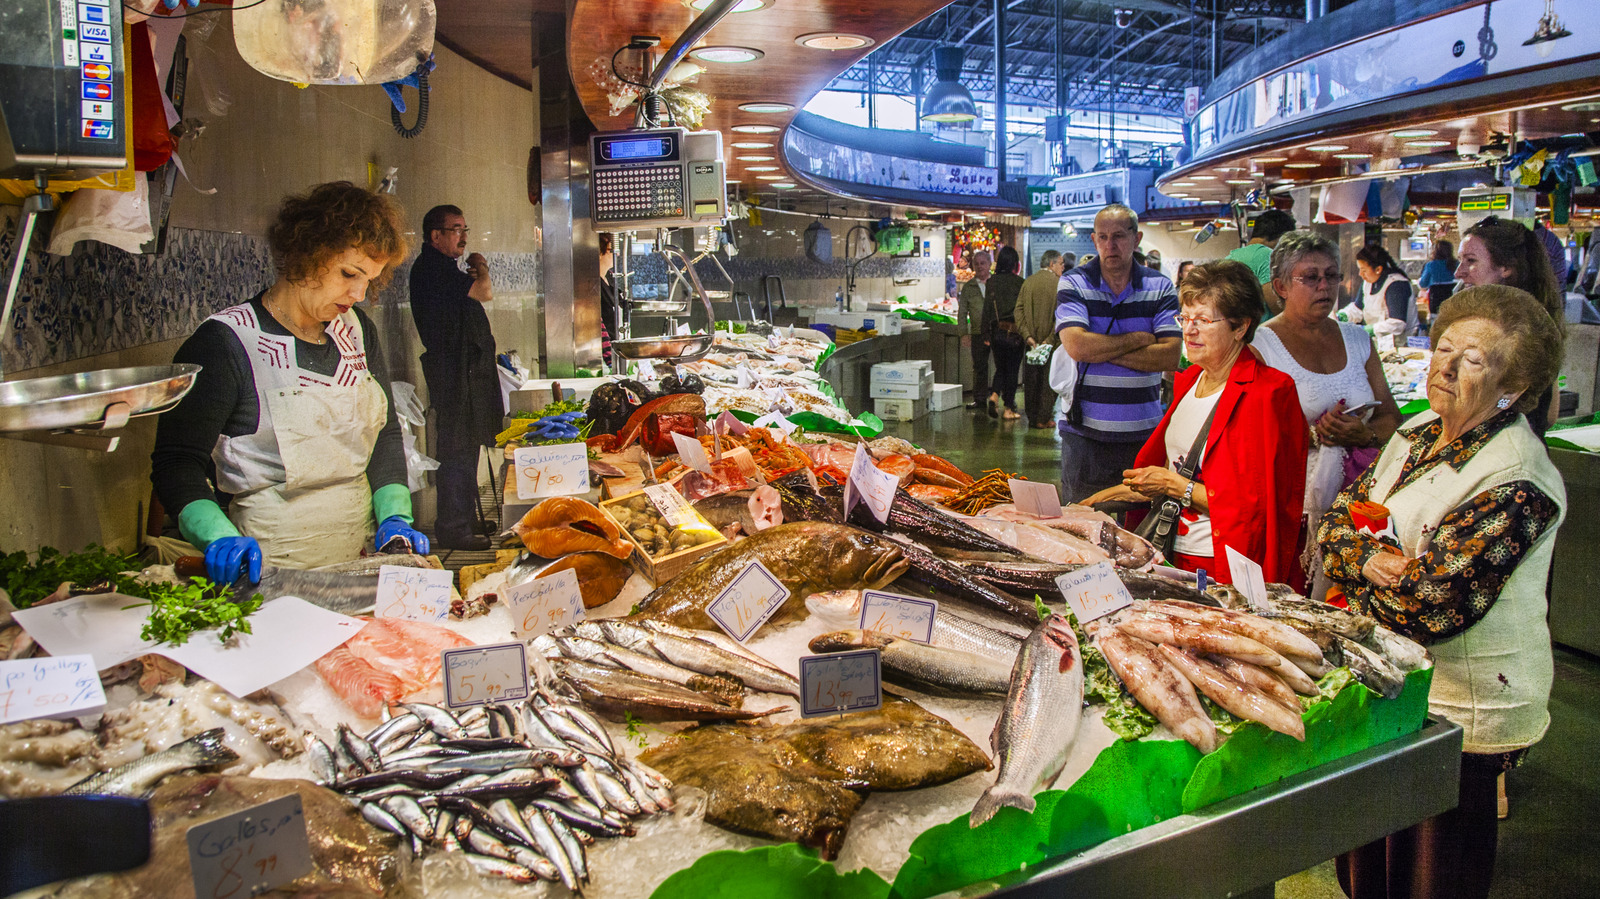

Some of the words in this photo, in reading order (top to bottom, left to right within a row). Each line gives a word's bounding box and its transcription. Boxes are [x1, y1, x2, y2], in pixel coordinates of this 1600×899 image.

[86, 27, 107, 36] VISA
[949, 167, 994, 186] Laura
[1032, 192, 1051, 206] DE
[1056, 190, 1094, 207] BACALLA
